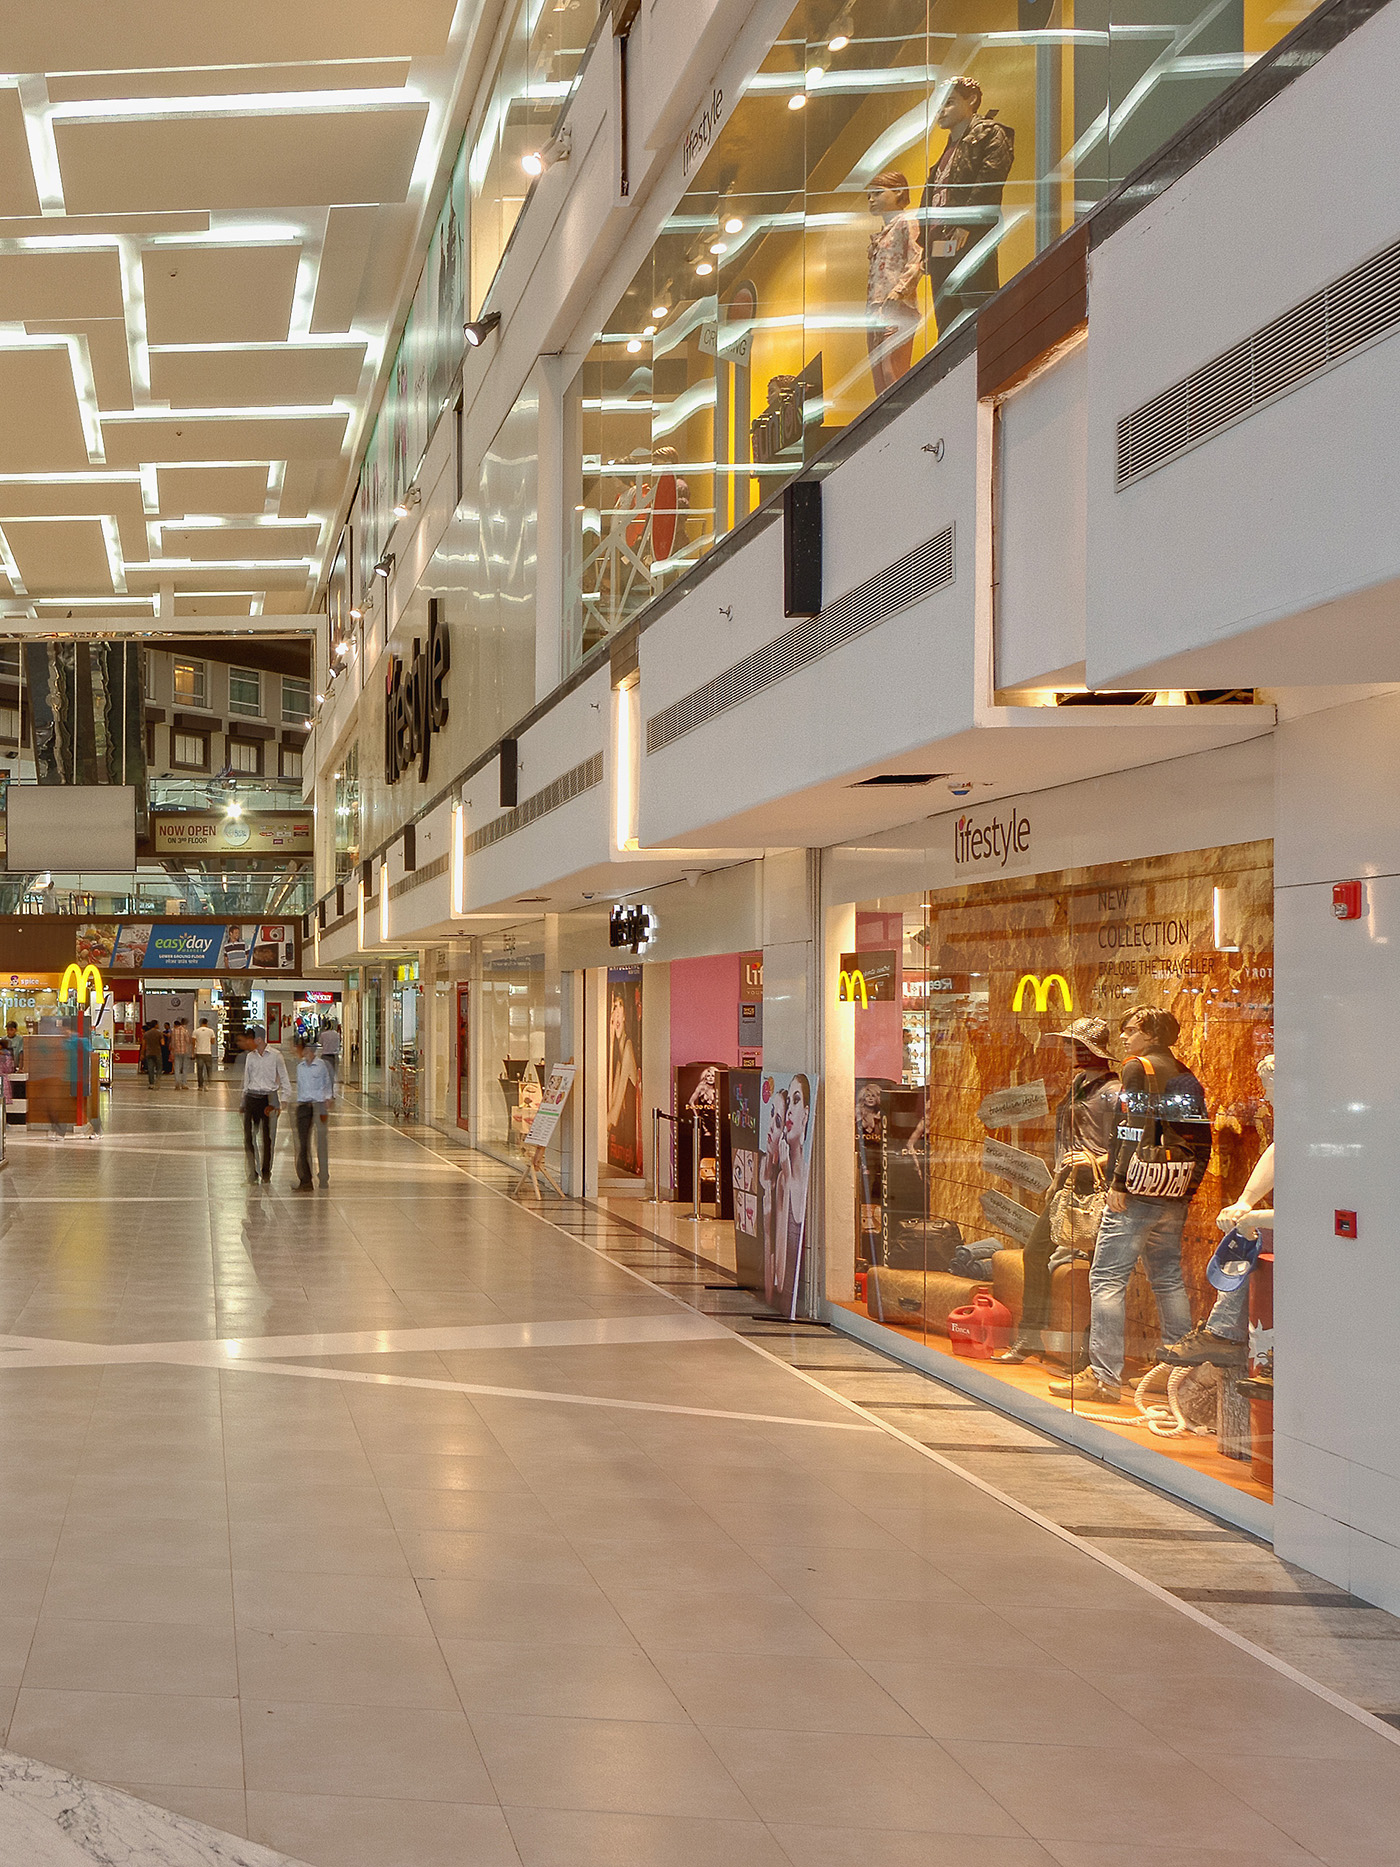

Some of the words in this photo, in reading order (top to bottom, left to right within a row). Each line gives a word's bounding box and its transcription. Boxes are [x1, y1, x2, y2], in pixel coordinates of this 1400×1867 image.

[683, 89, 723, 176] lifestyle
[385, 598, 450, 785] lifestyle
[159, 825, 185, 836] NOW
[187, 825, 216, 836] OPEN
[954, 807, 1031, 868] lifestyle
[1098, 889, 1130, 911] NEW
[155, 934, 213, 953] easyday
[1098, 920, 1189, 948] COLLECTION
[1098, 960, 1137, 976] EXPLORE
[1140, 960, 1157, 974] THE
[1160, 957, 1215, 974] TRAVELLER
[20, 977, 40, 986] spice
[880, 1114, 889, 1208] rabanne
